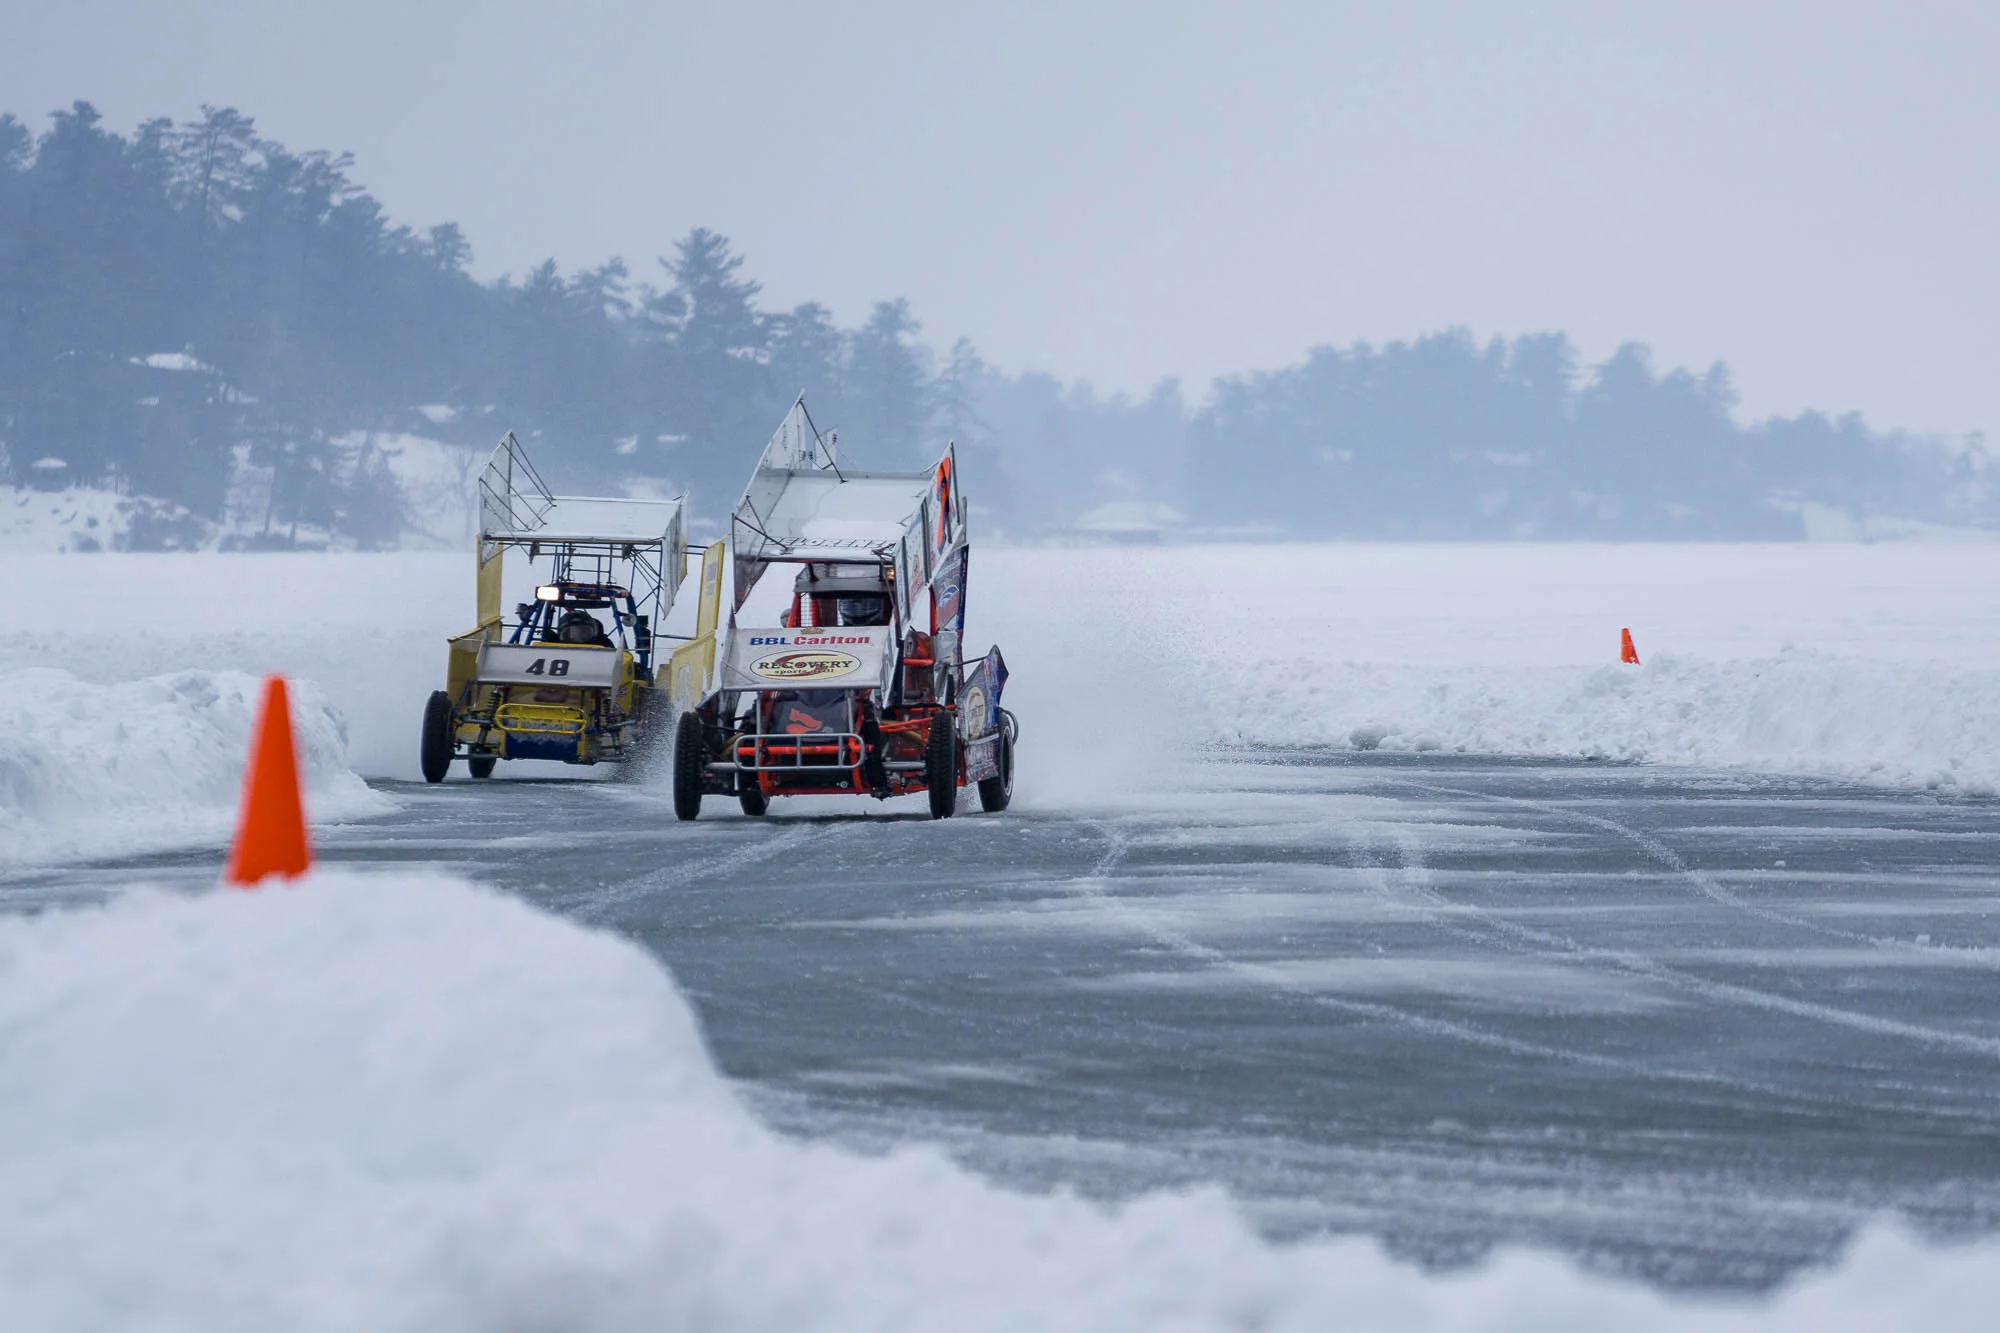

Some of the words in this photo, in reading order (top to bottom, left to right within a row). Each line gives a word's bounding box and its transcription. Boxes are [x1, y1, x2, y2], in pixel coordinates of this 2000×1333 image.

[749, 637, 791, 646] BBL
[793, 636, 870, 646] Carlton
[525, 658, 570, 676] 48
[759, 660, 853, 670] RECOVERY
